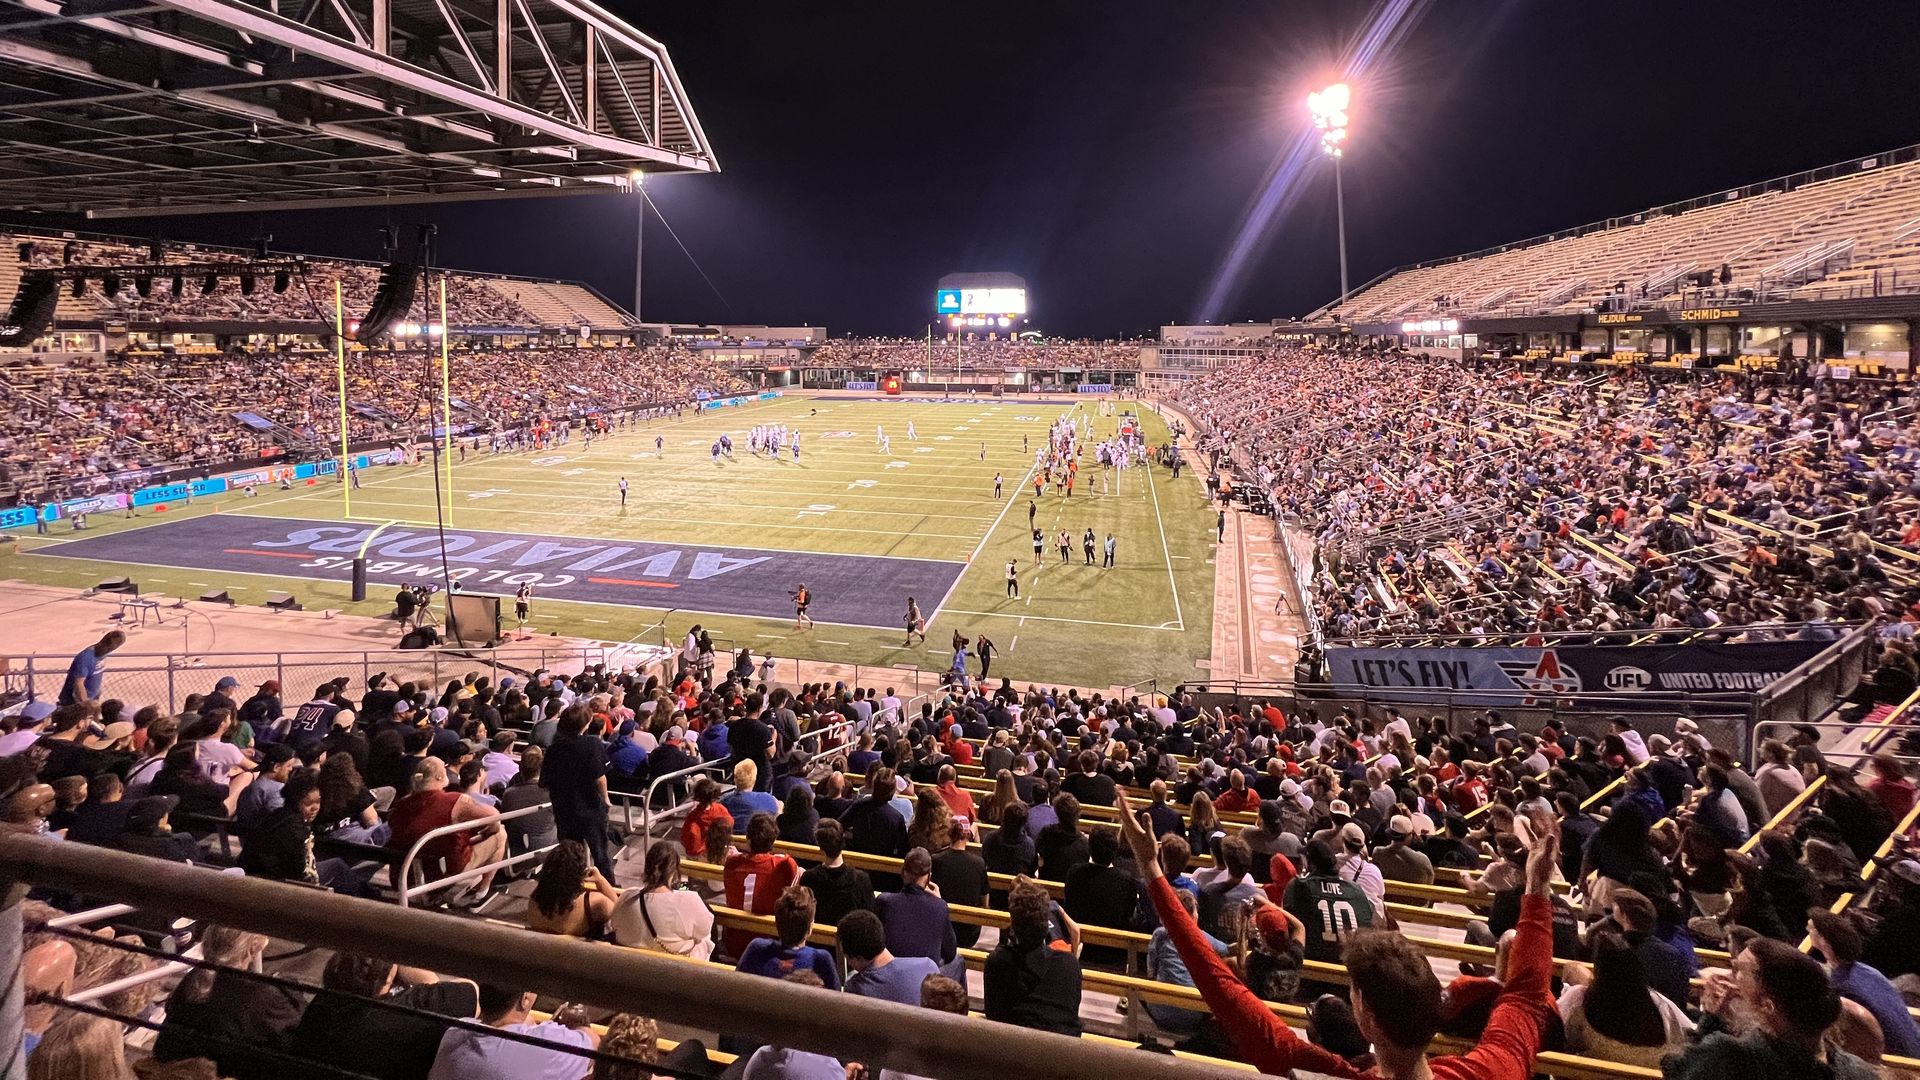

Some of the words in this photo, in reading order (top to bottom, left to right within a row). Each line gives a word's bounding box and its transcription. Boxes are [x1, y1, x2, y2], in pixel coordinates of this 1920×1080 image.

[1681, 309, 1721, 321] SCHMID
[145, 490, 170, 500] LESS
[172, 484, 206, 496] SUAR
[252, 526, 775, 580] AVIATORS
[1351, 659, 1416, 686] LET'S
[1417, 660, 1474, 690] FLY!
[1607, 673, 1652, 688] UFL
[1658, 672, 1713, 689] UNITED
[1713, 672, 1787, 689] FOOTBA
[1320, 881, 1343, 895] LOVE
[1317, 899, 1359, 942] 10
